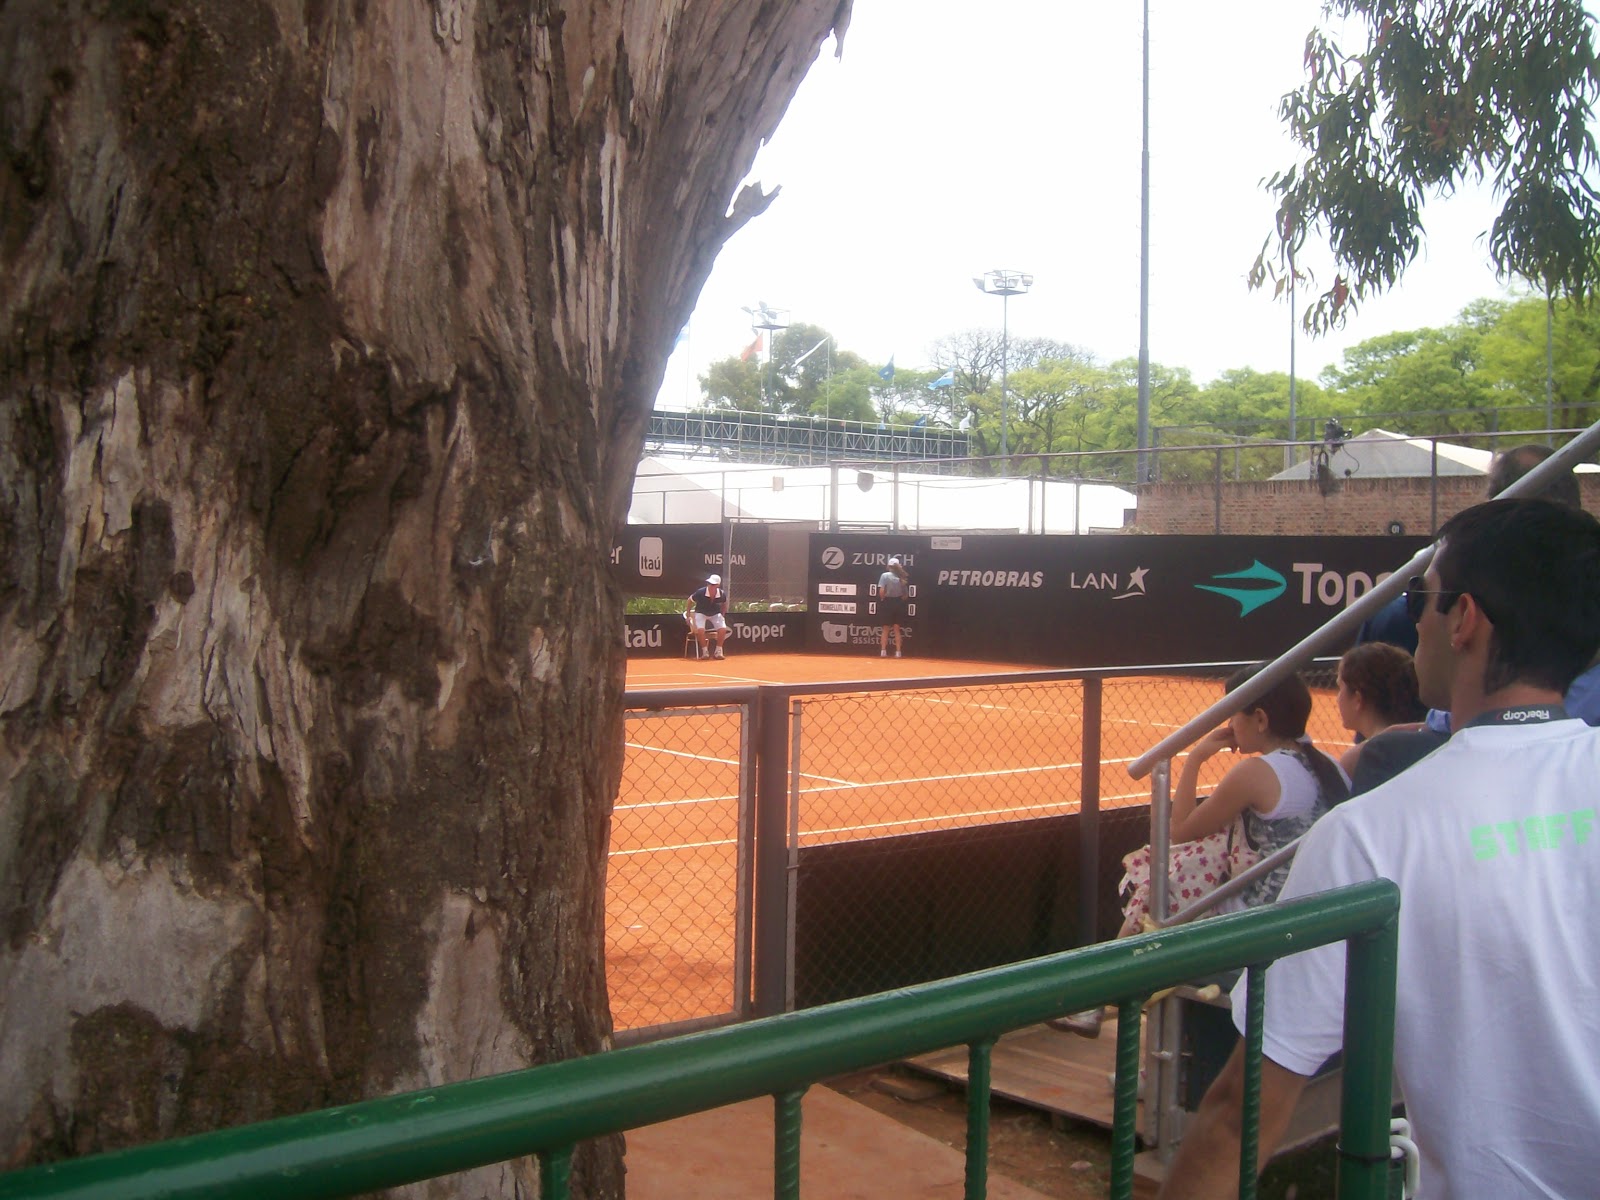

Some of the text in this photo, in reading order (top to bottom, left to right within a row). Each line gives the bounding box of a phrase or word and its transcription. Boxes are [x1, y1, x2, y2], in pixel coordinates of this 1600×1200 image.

[641, 556, 661, 570] Itaú
[704, 553, 746, 566] NISAN
[937, 570, 1044, 588] PETROBRAS
[1070, 572, 1118, 590] LAN
[870, 585, 876, 595] 6
[869, 602, 875, 614] 4
[624, 624, 662, 648] taú
[733, 622, 786, 643] Topper
[1502, 709, 1550, 722] FiberCorp
[1469, 807, 1596, 862] STAFF
